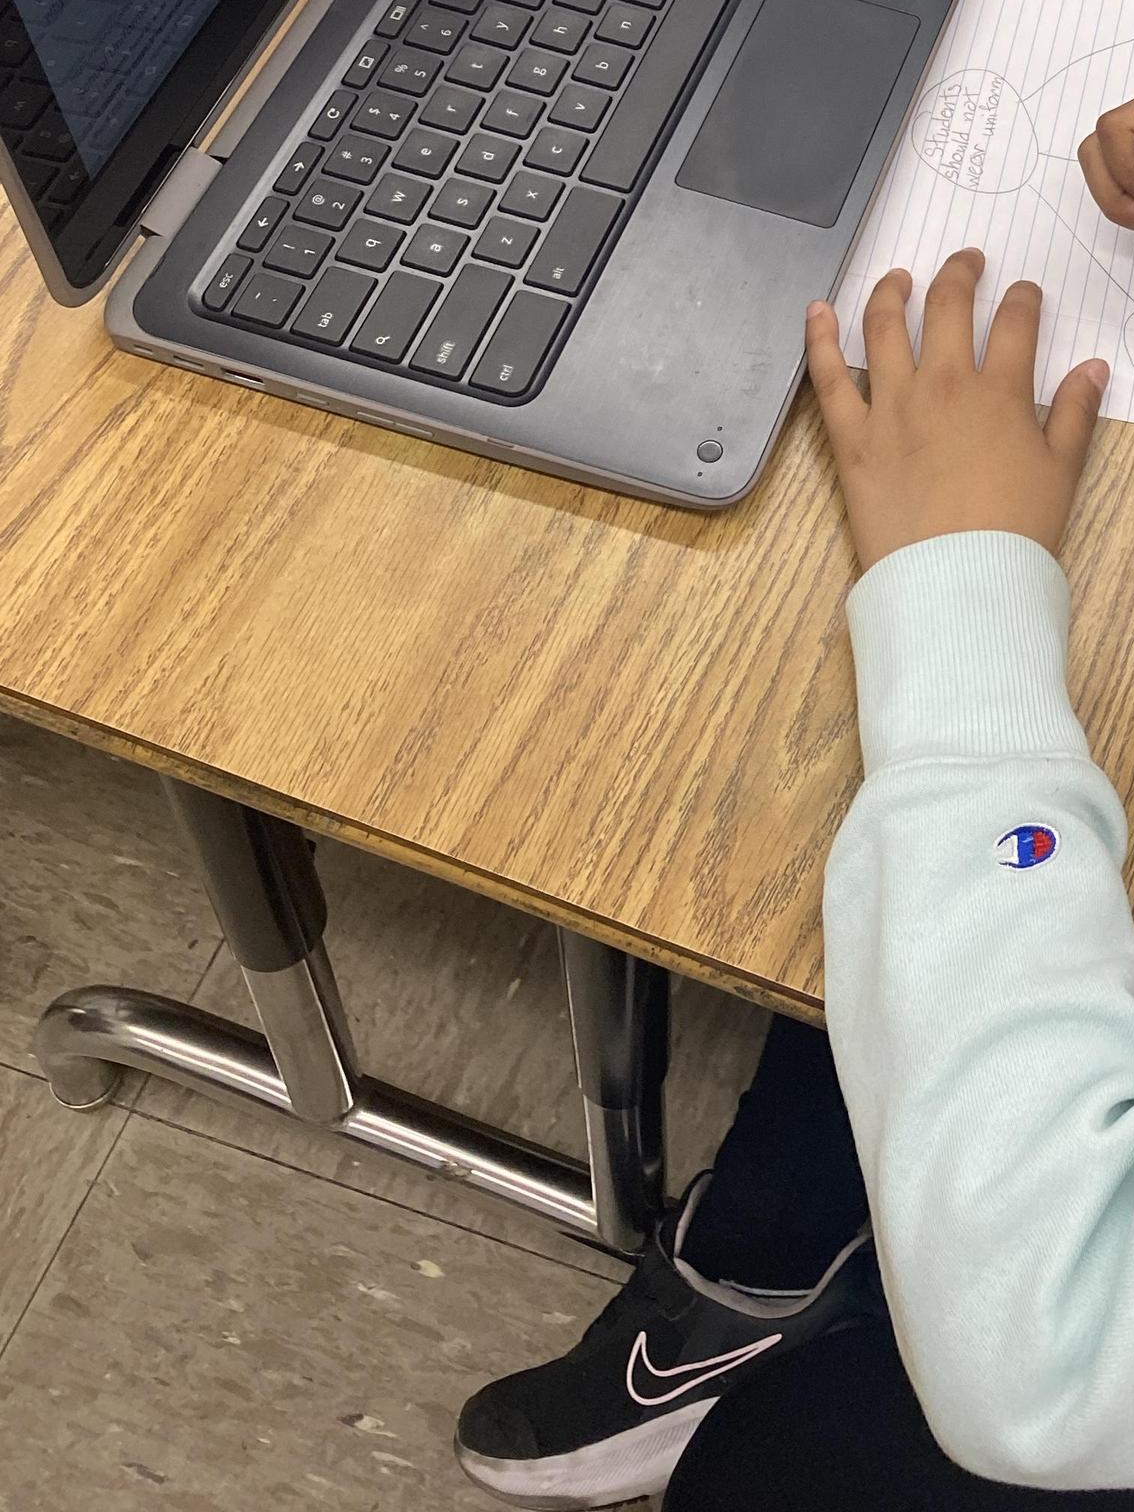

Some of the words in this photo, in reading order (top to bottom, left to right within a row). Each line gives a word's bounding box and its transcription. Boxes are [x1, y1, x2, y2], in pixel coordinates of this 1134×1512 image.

[924, 84, 961, 157] Students
[940, 131, 969, 179] should
[962, 86, 980, 122] not
[968, 144, 986, 187] wear
[979, 76, 1004, 137] uniform
[218, 271, 235, 289] esc
[316, 312, 335, 328] tab
[436, 340, 456, 365] shift
[499, 362, 514, 382] ctrl
